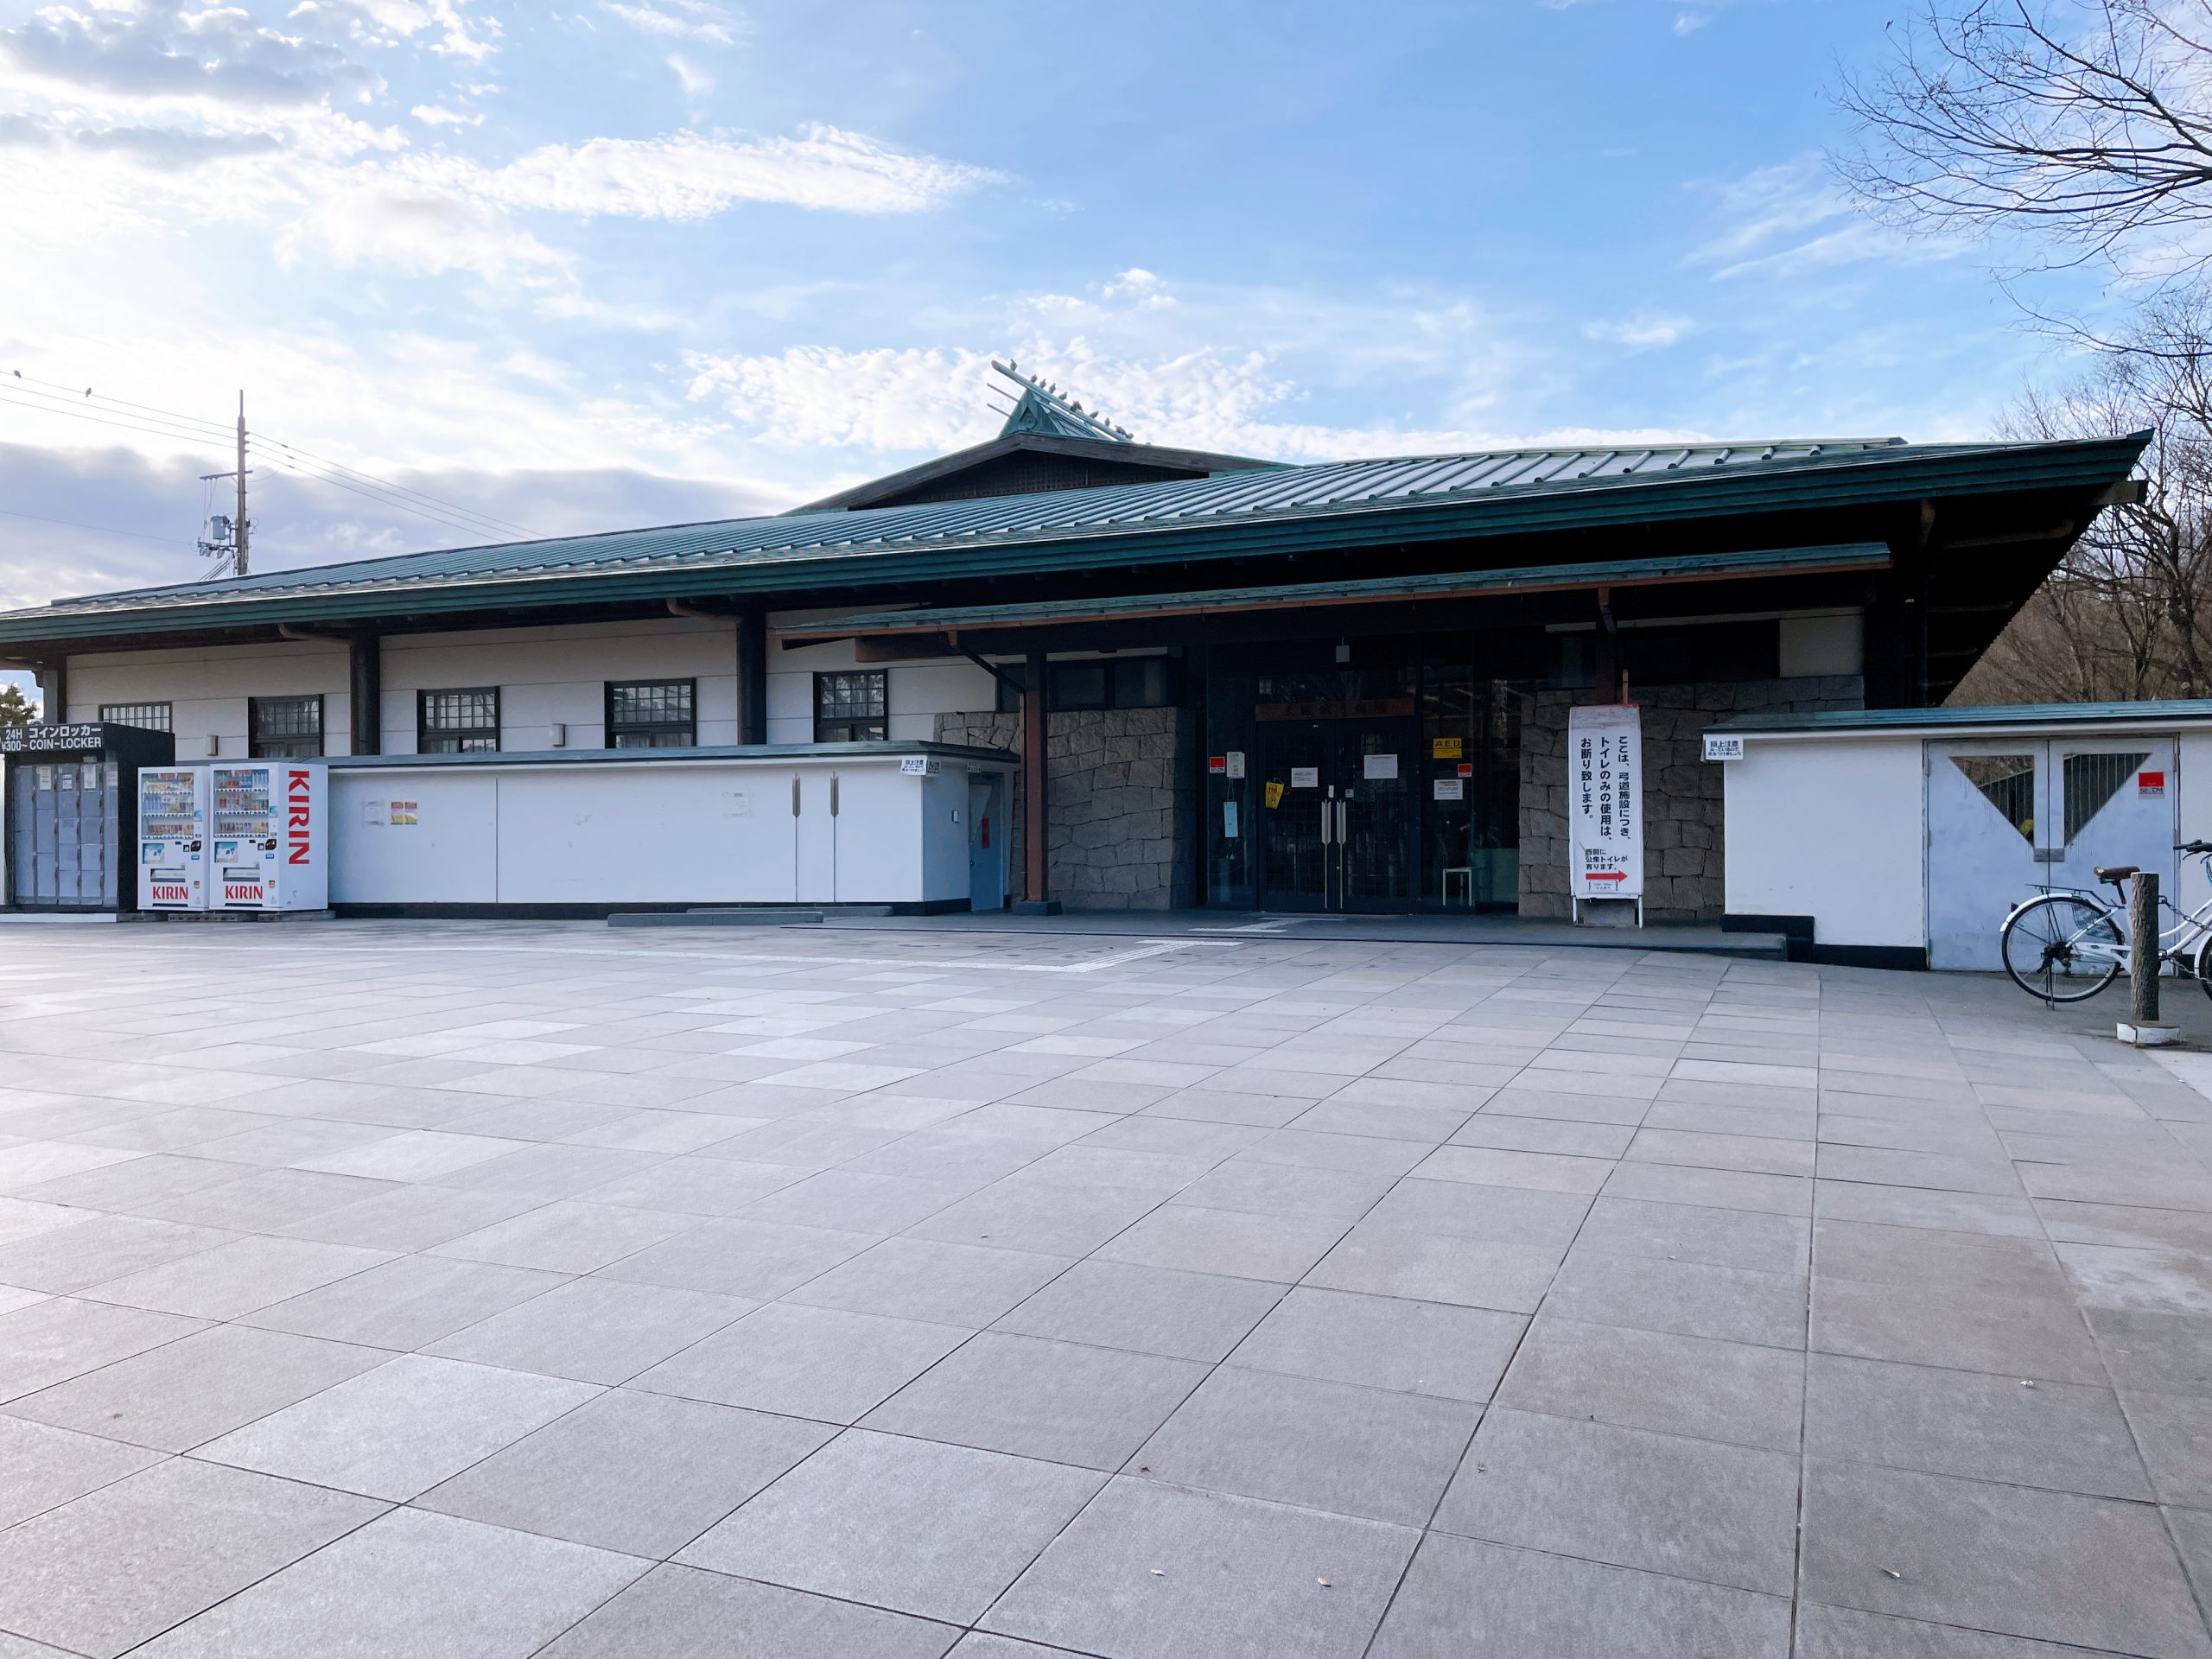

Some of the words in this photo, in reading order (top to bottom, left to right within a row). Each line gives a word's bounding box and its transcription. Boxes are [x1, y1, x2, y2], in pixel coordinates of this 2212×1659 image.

[5, 728, 22, 741] 24H
[29, 725, 102, 739] コインロッカー
[29, 737, 102, 750] COIN-LOCKER
[1580, 738, 1593, 819] お断り致します。
[1599, 736, 1611, 841] トイレのみの使用は、
[288, 770, 310, 865] KIRIN
[152, 886, 188, 899] KIRIN
[225, 885, 263, 899] KIRIN
